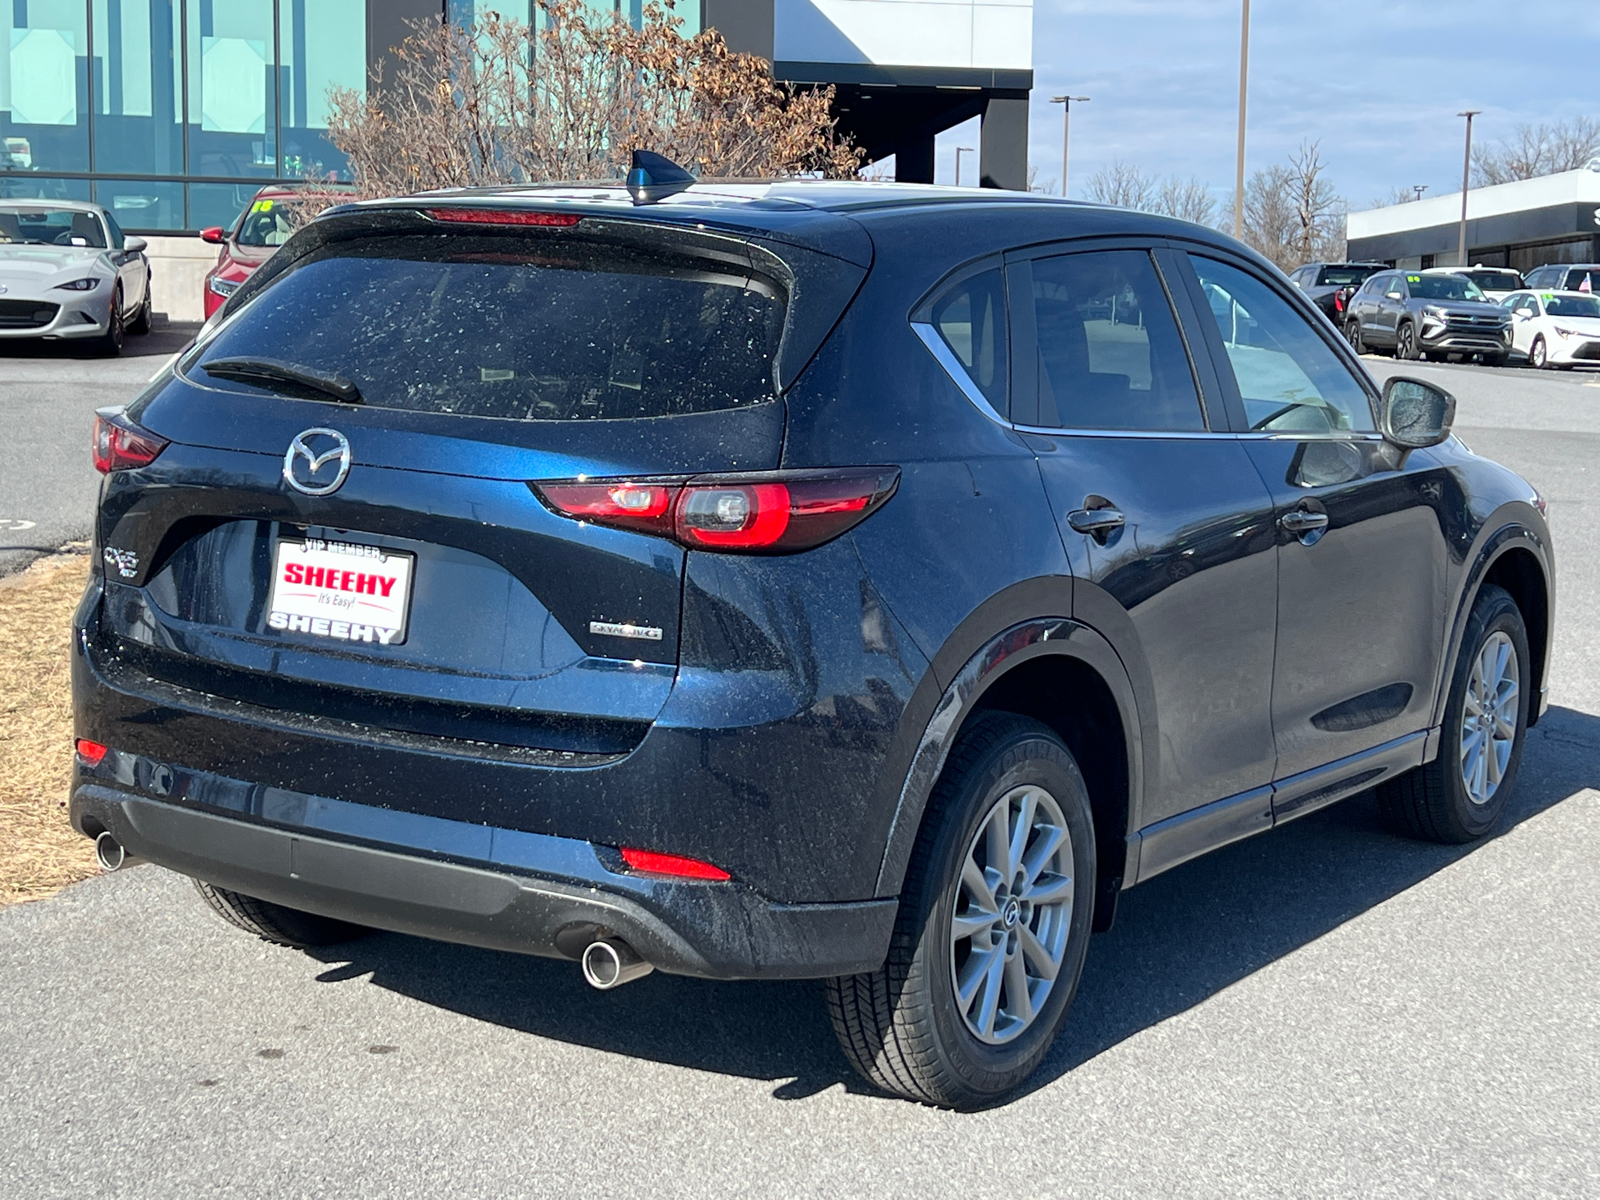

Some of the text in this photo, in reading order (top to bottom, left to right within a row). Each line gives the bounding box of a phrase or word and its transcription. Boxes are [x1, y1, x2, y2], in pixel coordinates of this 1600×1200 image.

[304, 538, 381, 558] VIP MEMBER
[283, 563, 397, 597] SHEEHY
[317, 592, 356, 610] It's Easy!
[268, 612, 397, 645] SHEEHY
